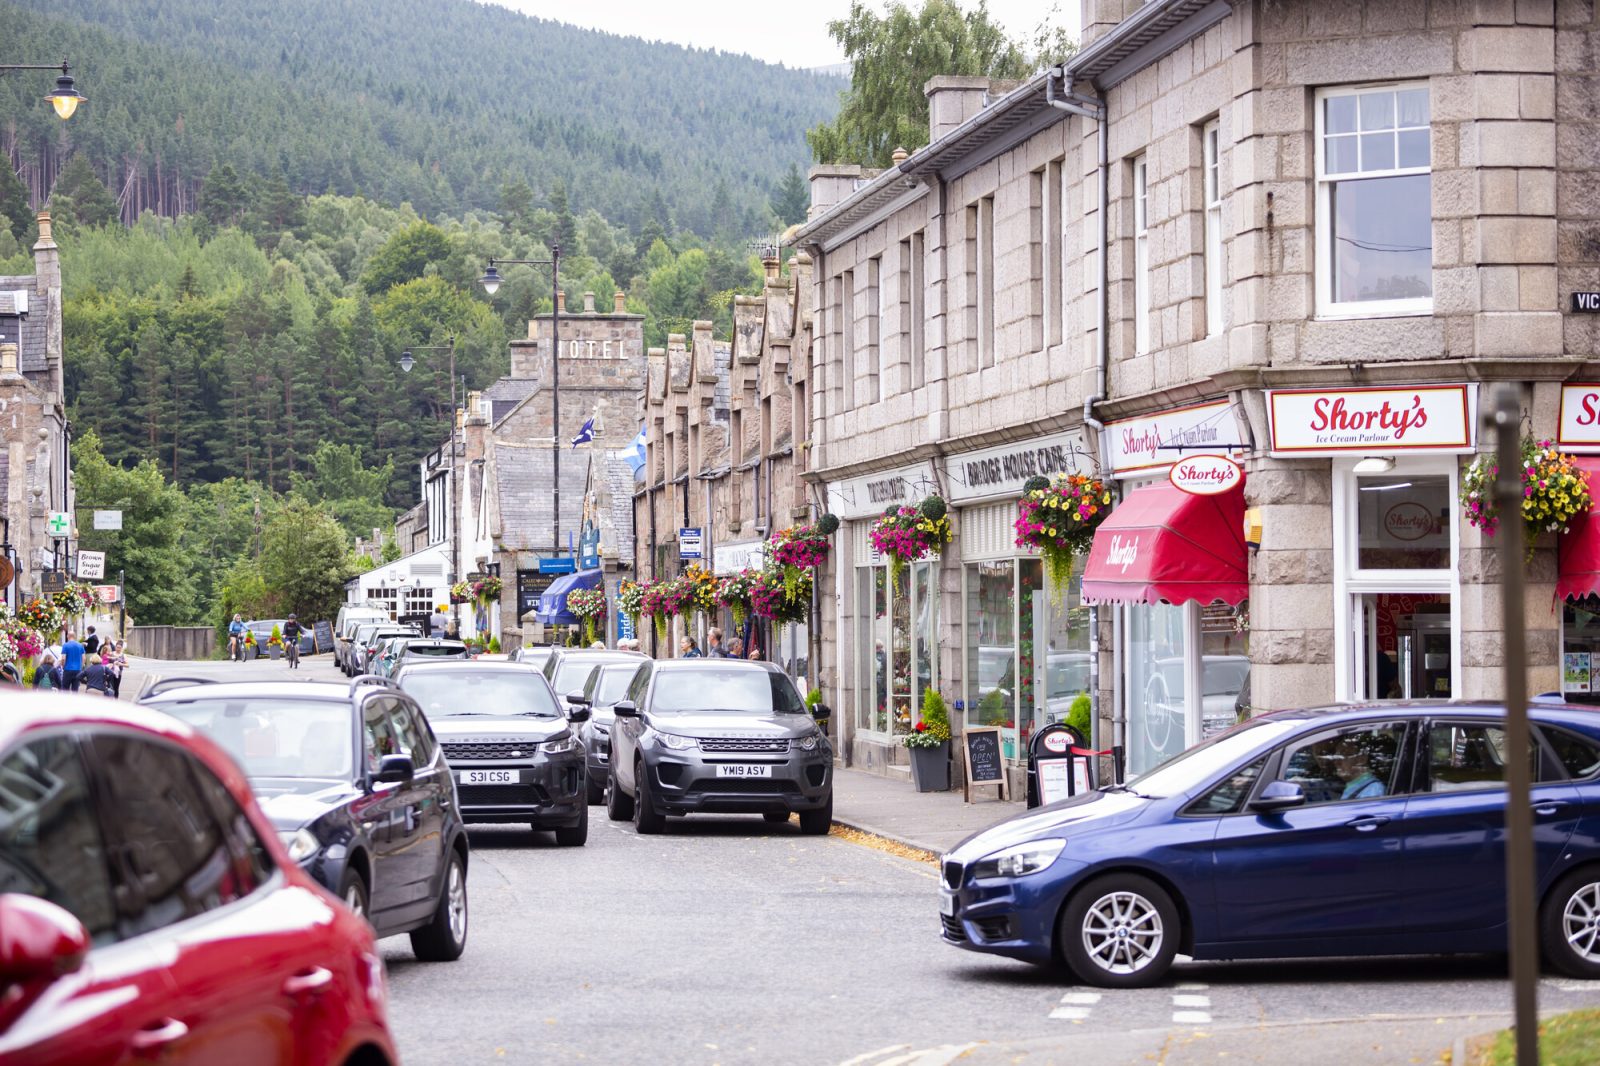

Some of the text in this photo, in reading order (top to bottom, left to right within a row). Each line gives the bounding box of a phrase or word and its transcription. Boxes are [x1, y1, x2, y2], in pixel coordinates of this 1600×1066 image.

[1577, 293, 1600, 310] VIC
[1310, 394, 1428, 440] Shorty's
[1576, 393, 1600, 426] S
[1122, 423, 1162, 459] Shorty's
[1316, 433, 1391, 443] Ice Cream Parlour
[966, 457, 1002, 488] BRIDGE
[1002, 450, 1037, 480] HOUSE
[1178, 465, 1234, 484] Shorty's
[1389, 513, 1429, 529] Shorty's
[81, 553, 102, 561] Brown
[1106, 535, 1139, 574] Shorty's
[82, 561, 100, 569] Sugar
[470, 771, 510, 782] S31 CSG
[723, 766, 765, 776] YM19 ASV
